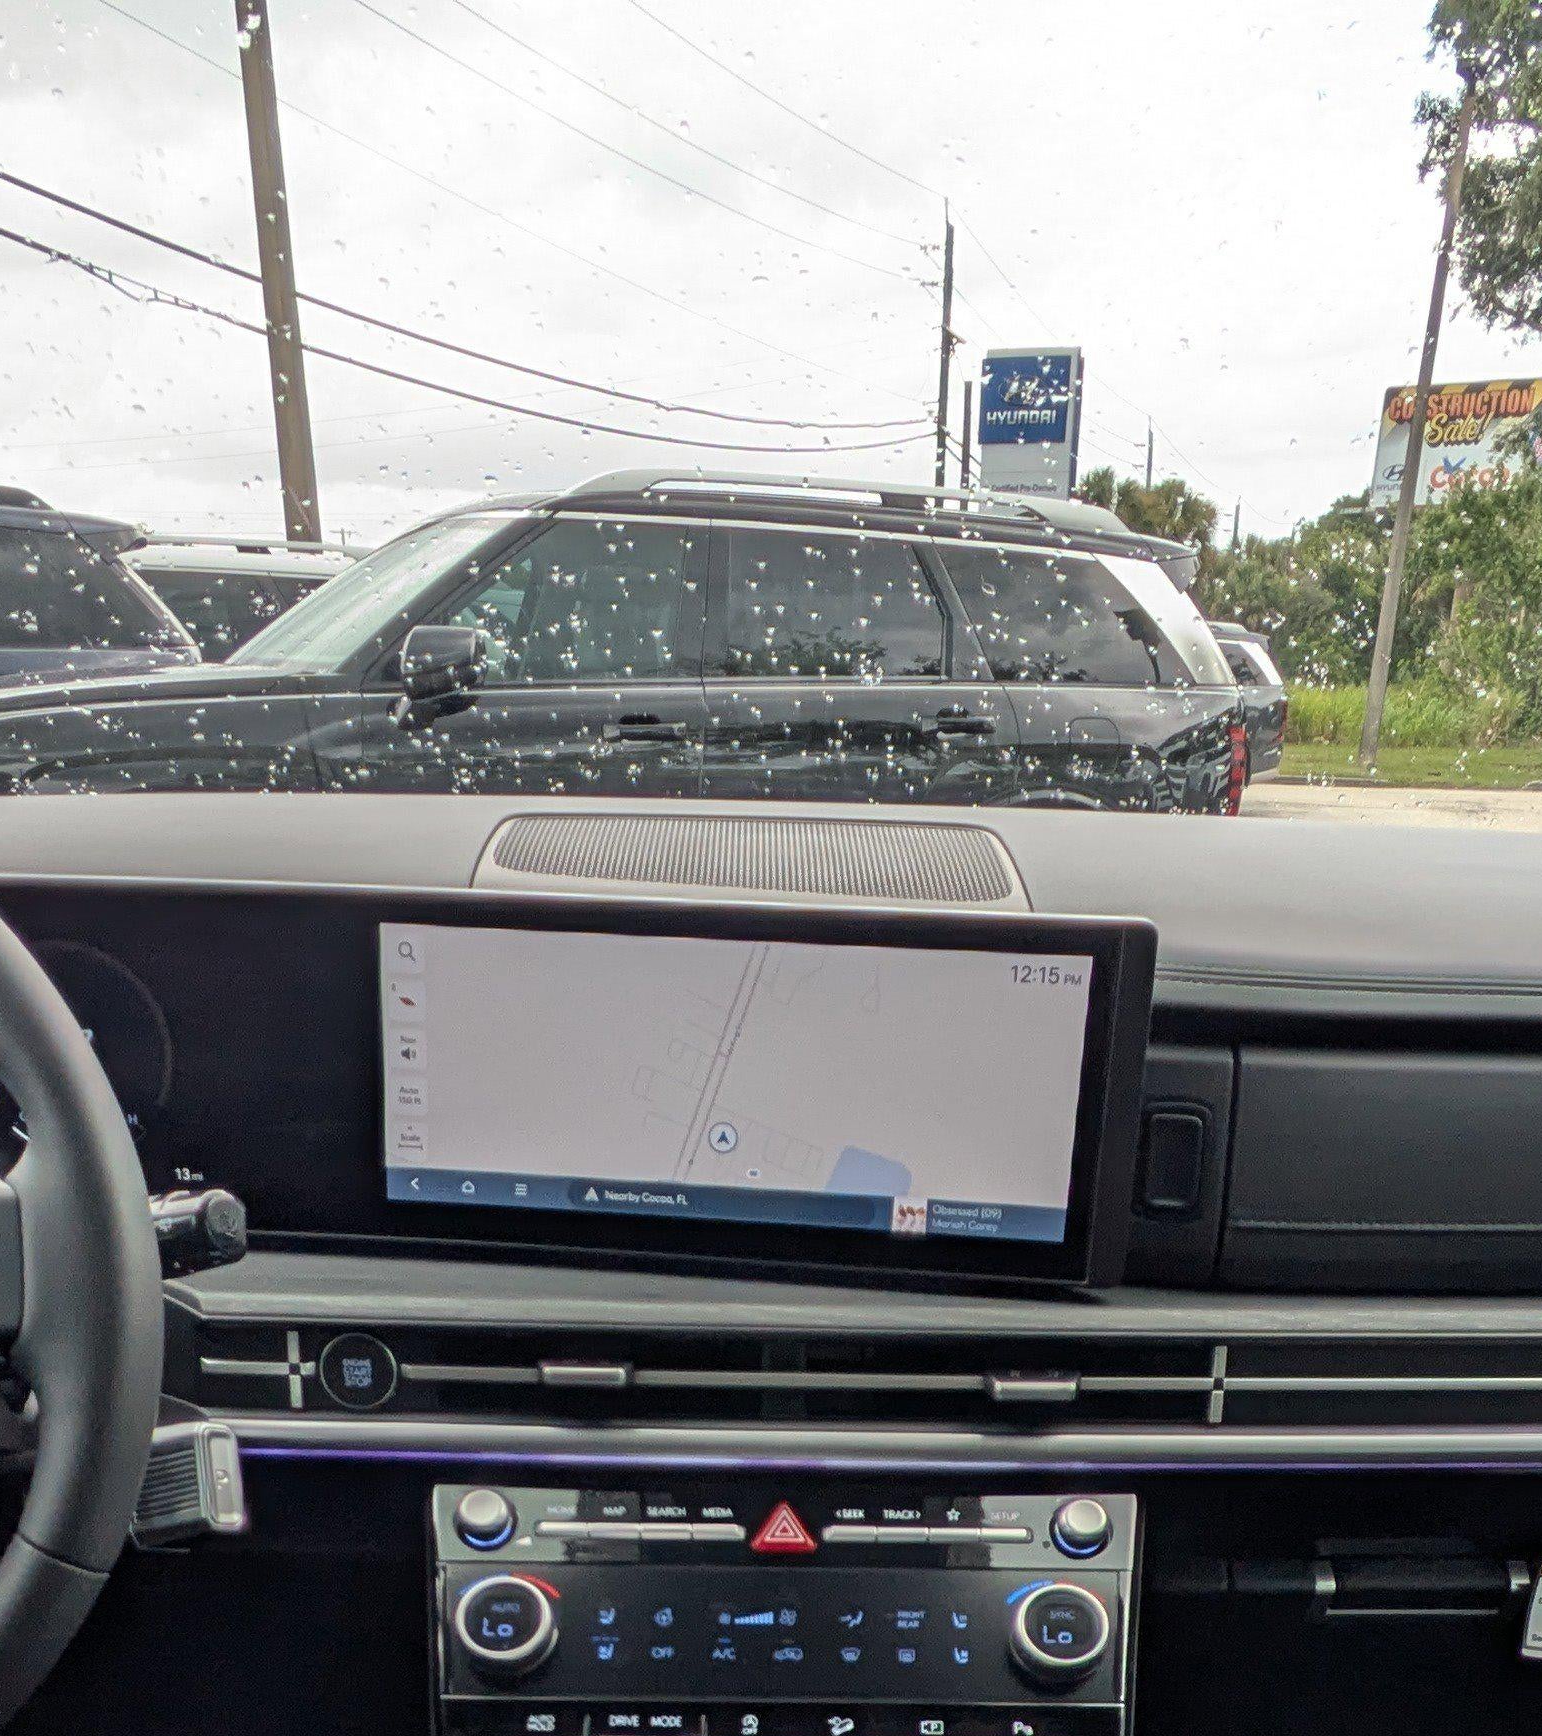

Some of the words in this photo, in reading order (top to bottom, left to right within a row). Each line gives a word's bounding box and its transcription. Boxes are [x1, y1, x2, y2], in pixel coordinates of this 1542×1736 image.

[1389, 387, 1536, 421] COSTRUCTION
[986, 410, 1057, 425] HYUNDAI
[1426, 412, 1496, 446] Sale!
[1011, 965, 1060, 984] 12:15
[1063, 974, 1082, 985] PM
[604, 1189, 640, 1203] Nearby
[932, 1219, 966, 1230] Mariah
[968, 1220, 999, 1232] Carey
[602, 1506, 627, 1517] MAP
[646, 1506, 687, 1517] SEARCH
[701, 1507, 733, 1518] MEDIA
[882, 1508, 914, 1520] TRACK
[481, 1617, 515, 1639] Lo
[1042, 1625, 1074, 1645] Lo
[651, 1646, 675, 1659] OFF
[712, 1647, 736, 1660] A/C
[609, 1714, 640, 1727] DRIVE
[650, 1715, 683, 1727] MODE
